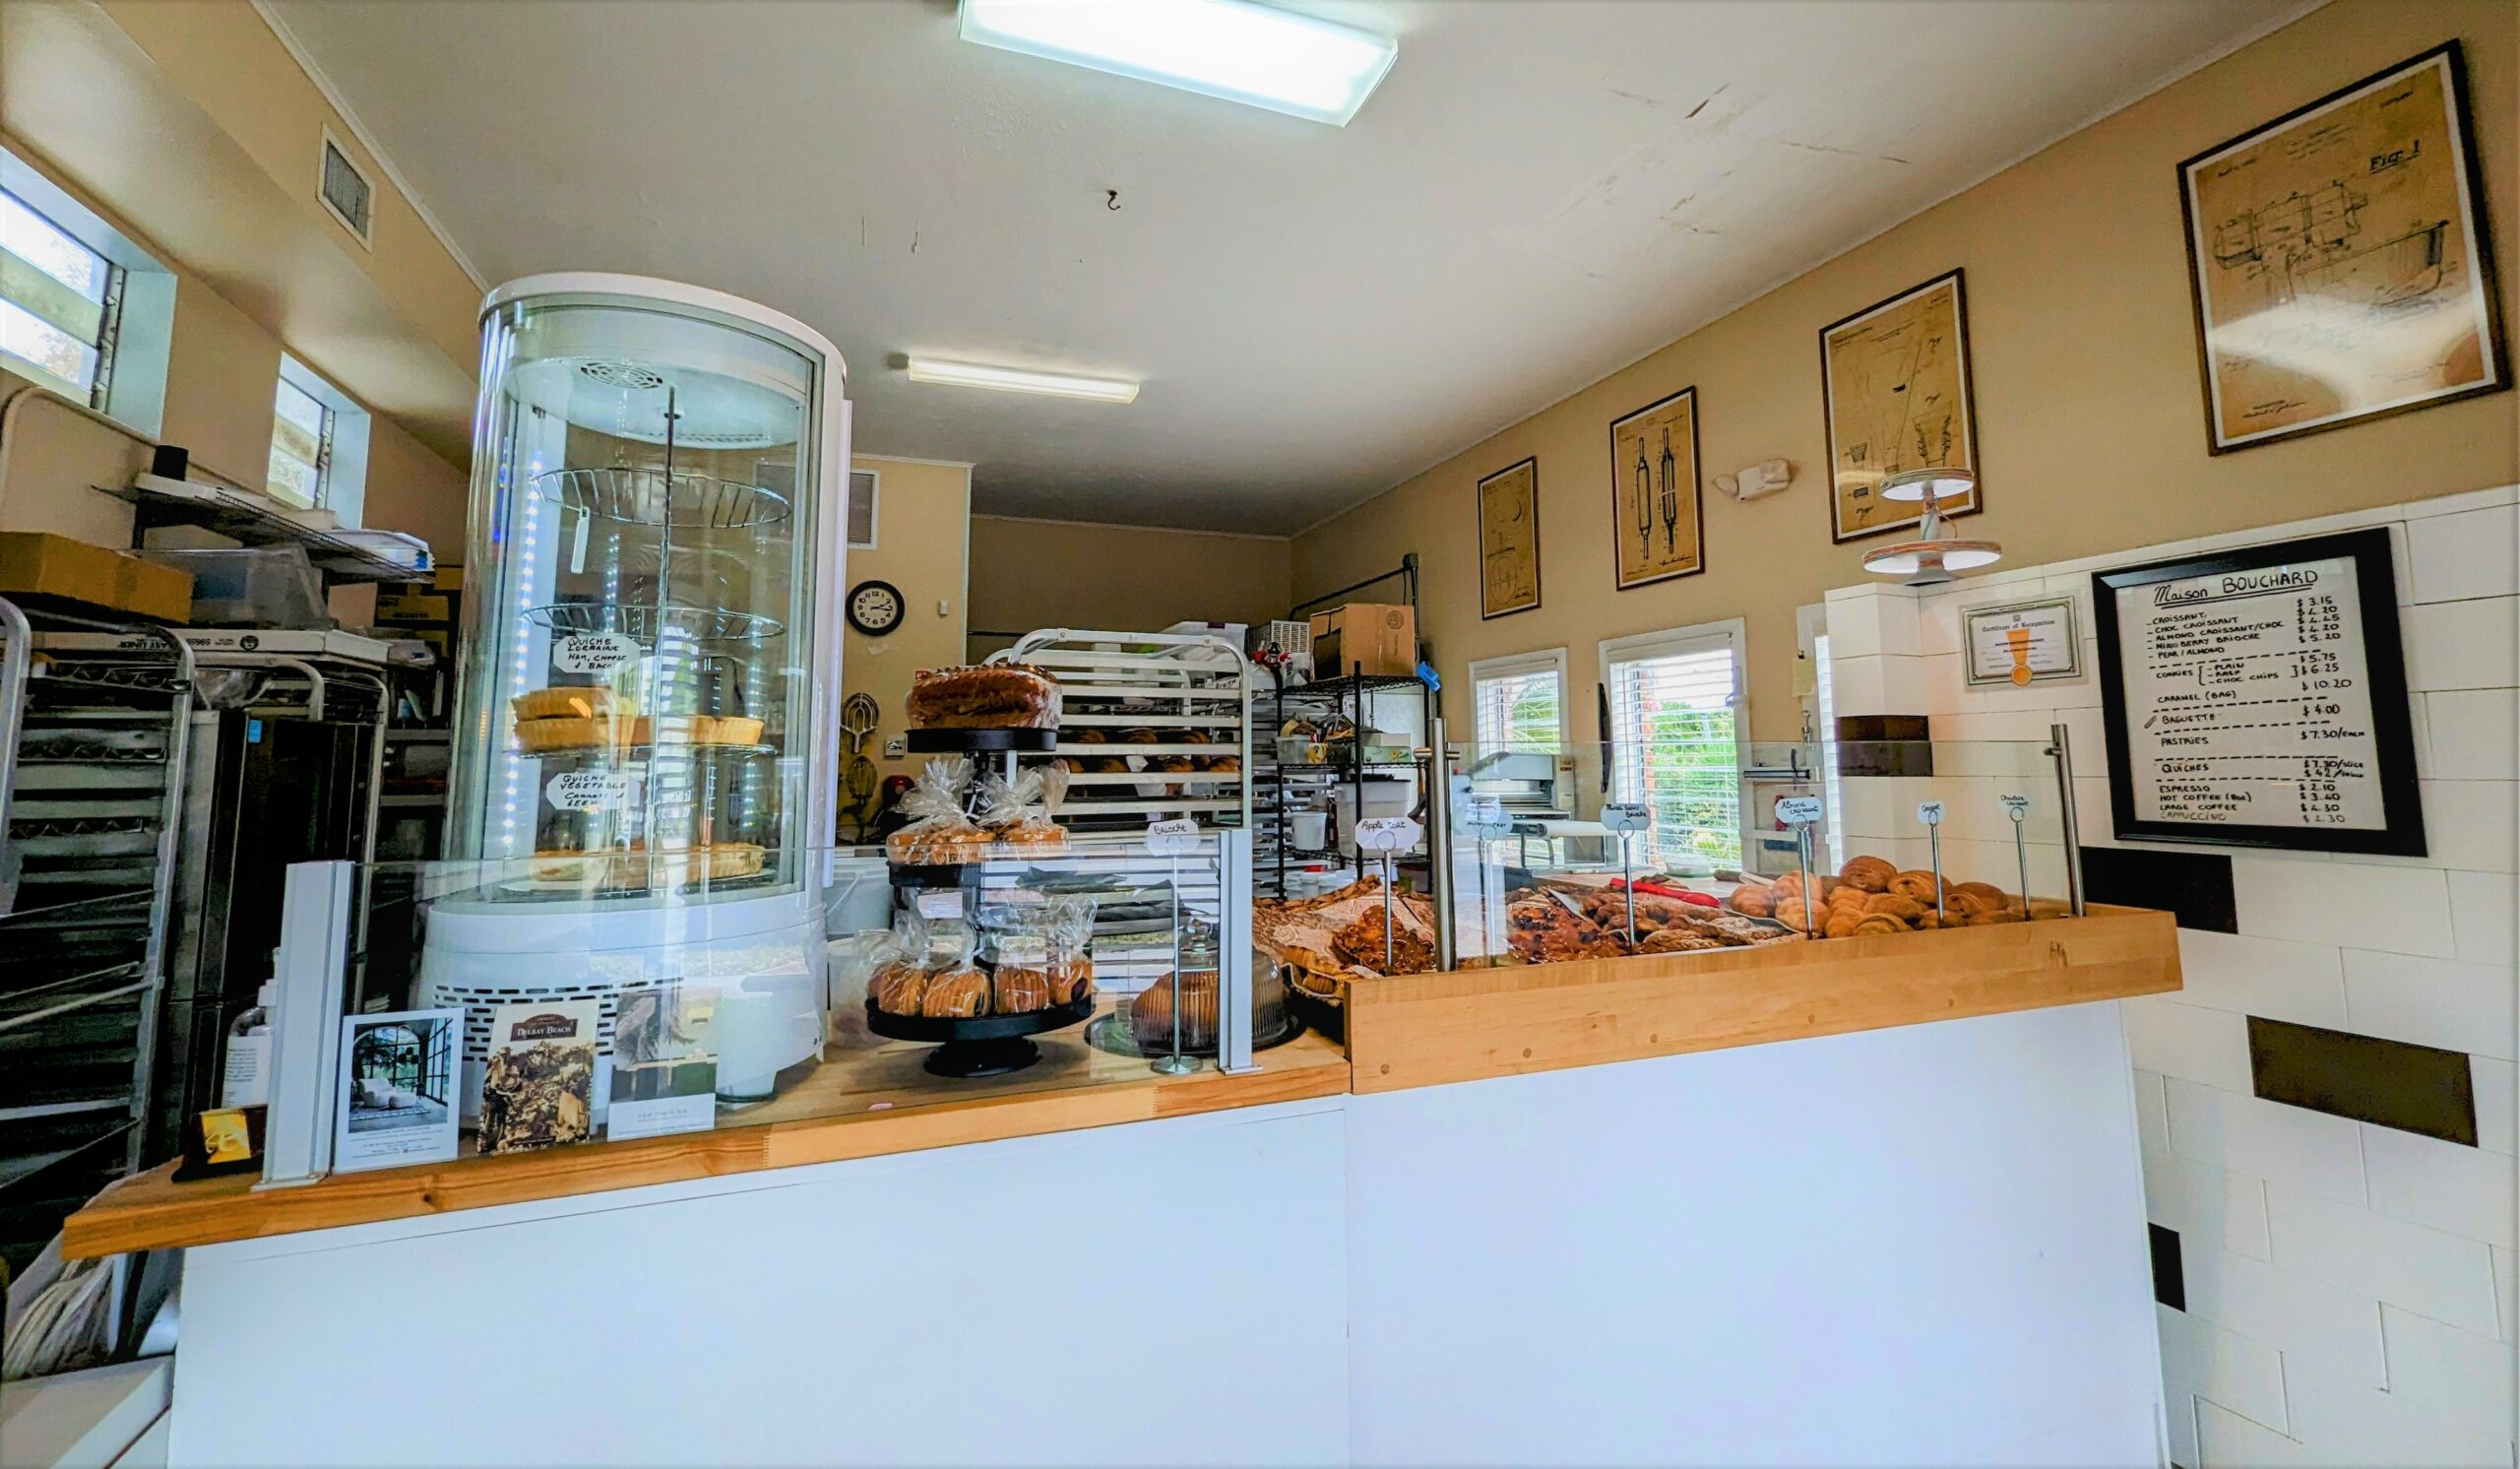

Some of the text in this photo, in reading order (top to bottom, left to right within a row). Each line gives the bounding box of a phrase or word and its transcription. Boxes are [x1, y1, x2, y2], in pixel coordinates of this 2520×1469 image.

[2153, 570, 2318, 604] Maison BOUCHARD
[2308, 596, 2333, 607] 3.15
[2183, 616, 2238, 629] CROISSANT
[2307, 606, 2338, 615] 4.20
[567, 637, 612, 646] QUICHE
[2156, 631, 2195, 642] ALMOND
[2180, 638, 2210, 648] BERRY
[2216, 633, 2261, 644] BRIOCHE
[2186, 646, 2226, 656] ALMOND
[2309, 632, 2341, 643] 5.20
[2214, 662, 2244, 671] PLAIN
[2156, 670, 2194, 679] COOKIES
[2248, 671, 2280, 681] CHIPS
[2157, 693, 2201, 704] CARAMEL
[2205, 689, 2236, 701] (BAG)
[2313, 677, 2353, 690] 10.20
[2162, 713, 2216, 725] BAGUETTE
[2314, 703, 2341, 715] 4.00
[2161, 735, 2209, 747] PASTRIES
[2162, 762, 2210, 774] QUICHES
[560, 782, 627, 791] VEGETABLE
[2159, 785, 2211, 794] ESPRESSO
[2310, 783, 2336, 792] 2.10
[2182, 794, 2222, 802] COFFEE
[2197, 802, 2237, 811] COFFEE
[2160, 810, 2228, 821] CAPPUCCINO
[1360, 819, 1384, 833] Apple
[517, 1025, 571, 1037] DELRAY BEACH
